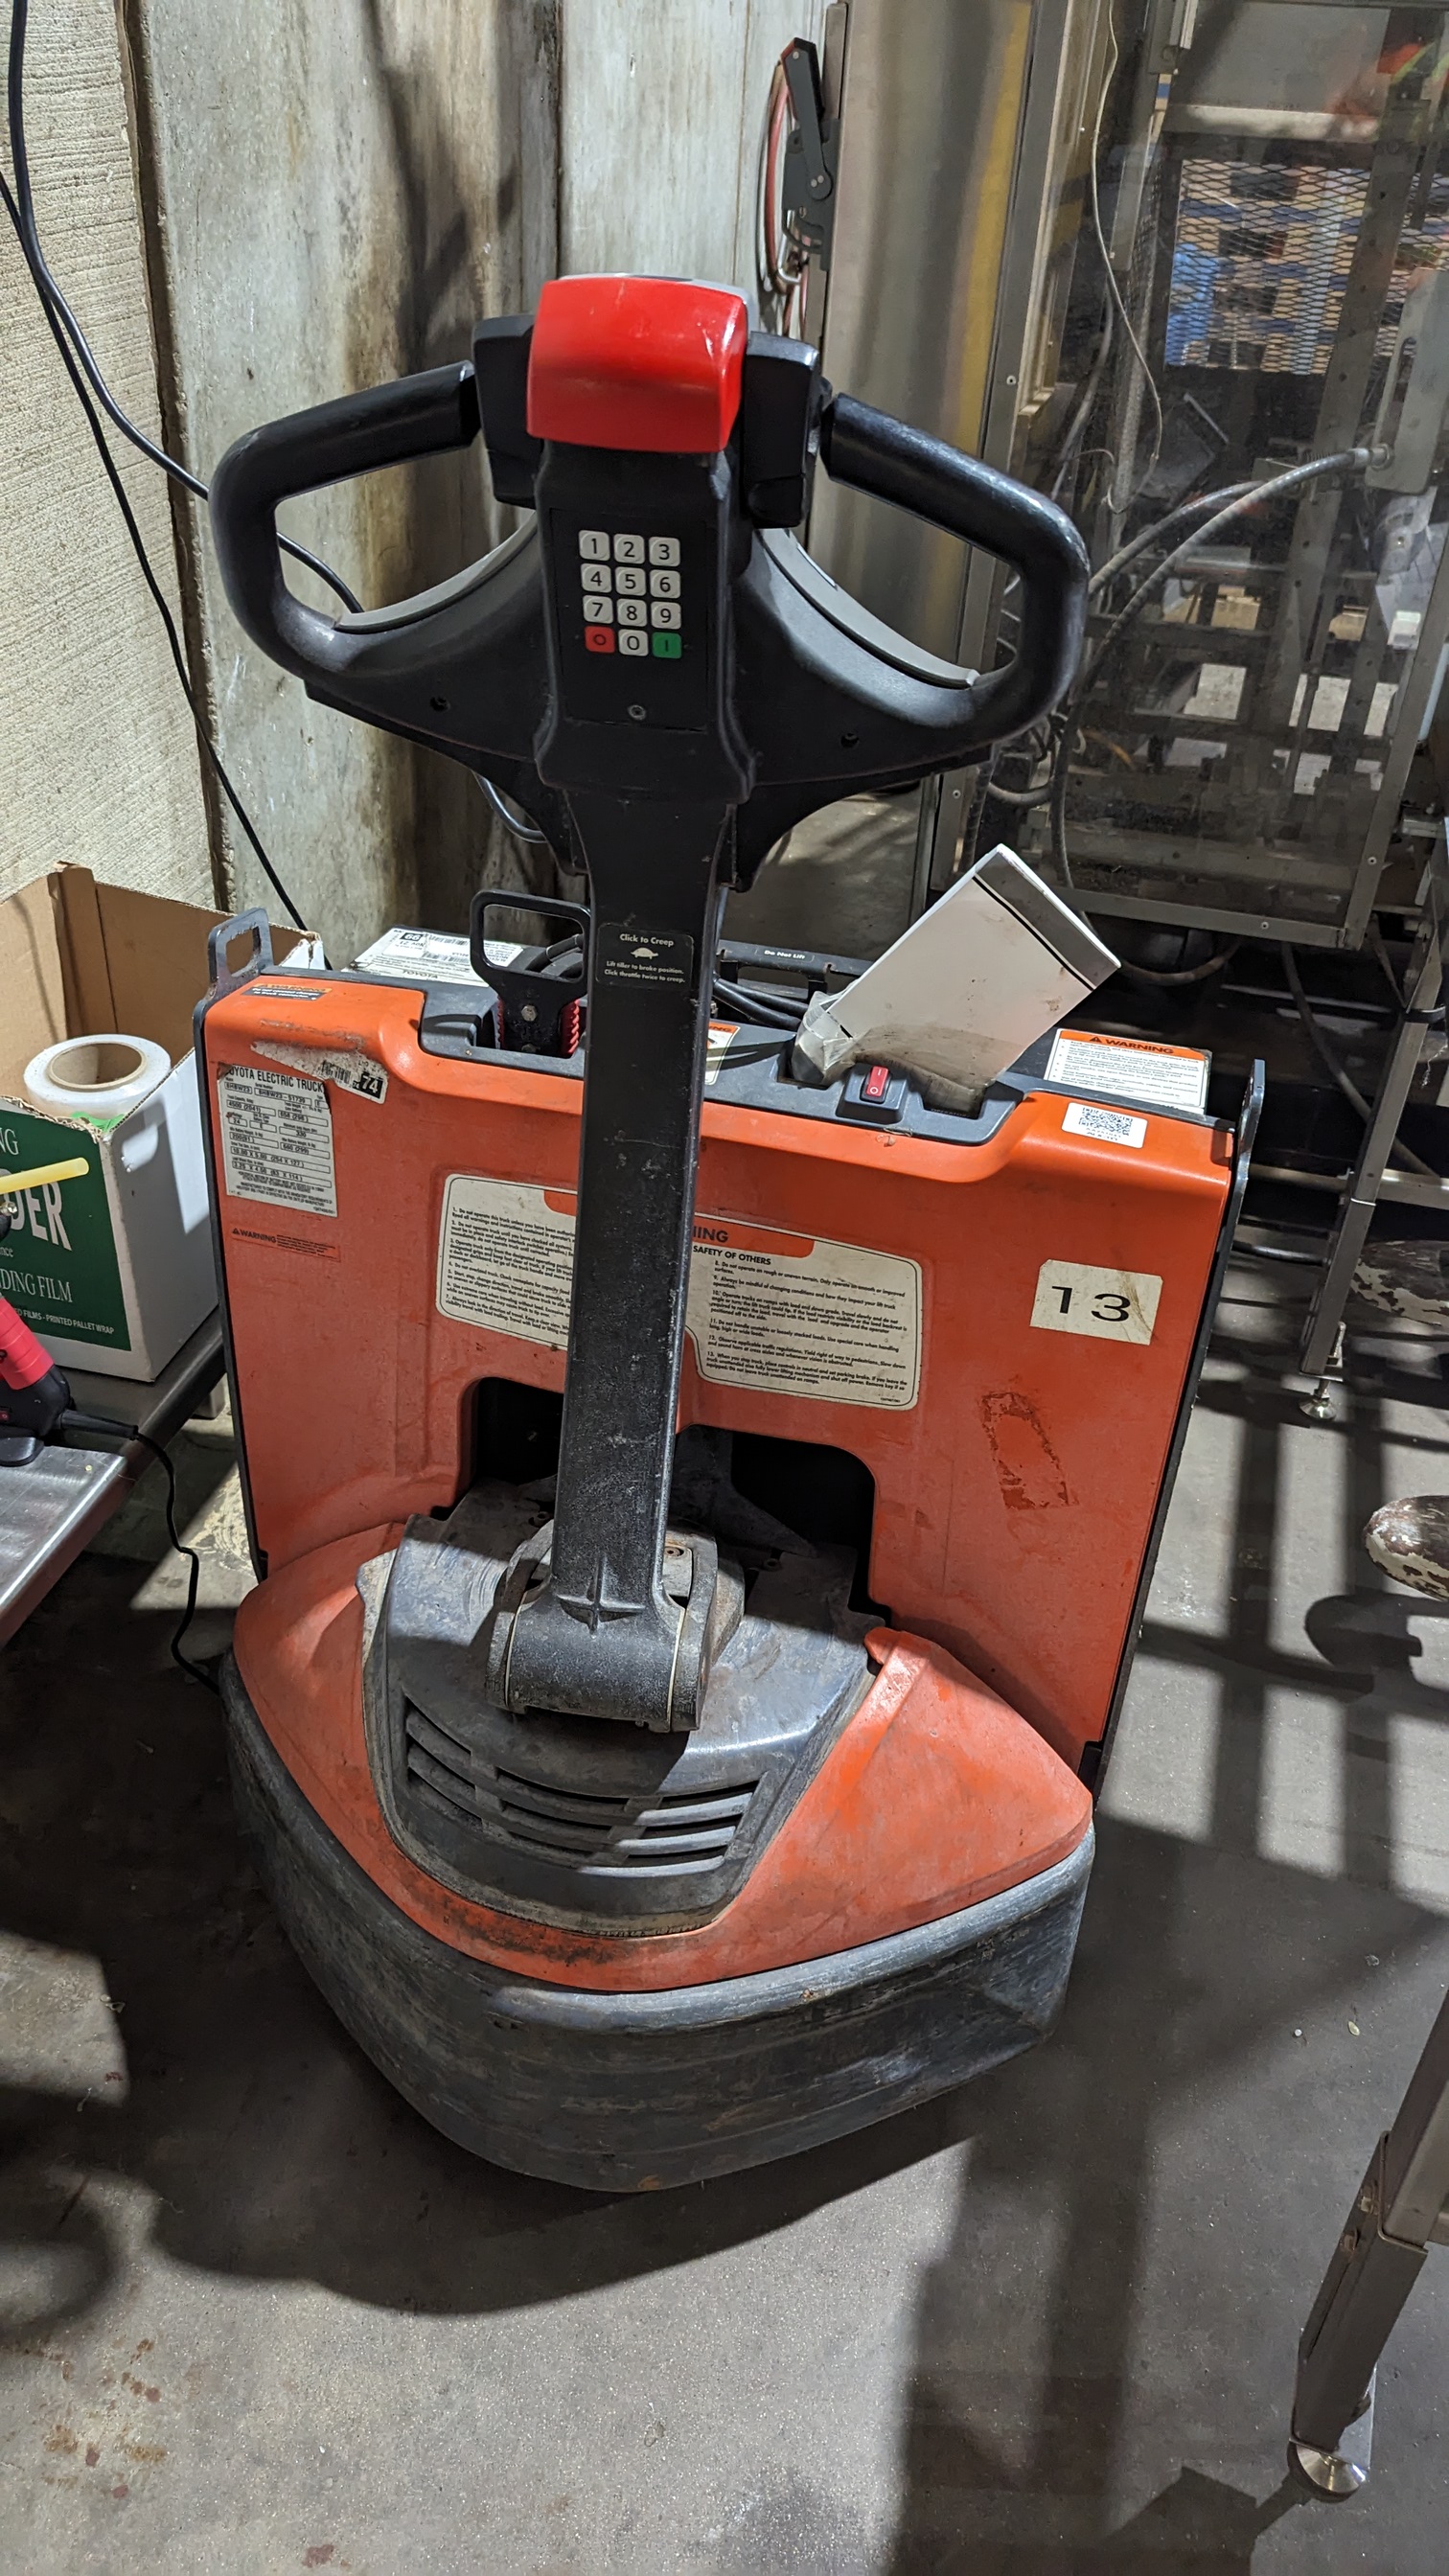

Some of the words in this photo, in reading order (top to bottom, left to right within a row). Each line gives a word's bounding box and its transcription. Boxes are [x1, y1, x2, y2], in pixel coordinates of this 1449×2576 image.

[591, 538, 597, 554] 1
[624, 541, 635, 558] 2
[658, 544, 670, 560] 3
[590, 571, 602, 586] 4
[625, 574, 636, 589] 5
[659, 577, 671, 592] 6
[592, 603, 604, 617] 7
[627, 606, 637, 620] 8
[660, 609, 671, 623] 9
[619, 933, 638, 943] Click
[651, 937, 674, 948] Creep
[402, 970, 438, 979] TOYOTA
[1105, 1039, 1174, 1055] WARNING
[258, 1070, 294, 1088] ELECTRIC
[297, 1079, 323, 1092] TRUCK
[362, 1075, 379, 1093] 74
[241, 1230, 276, 1244] WARNING
[693, 1245, 723, 1256] SAFETY
[724, 1251, 737, 1259] OF
[739, 1254, 771, 1265] OTHERS
[37, 1276, 73, 1302] FILM
[24, 1309, 42, 1321] FILMS
[46, 1314, 73, 1326] PRINTED
[73, 1320, 96, 1330] PALLET
[96, 1324, 114, 1335] WRAP
